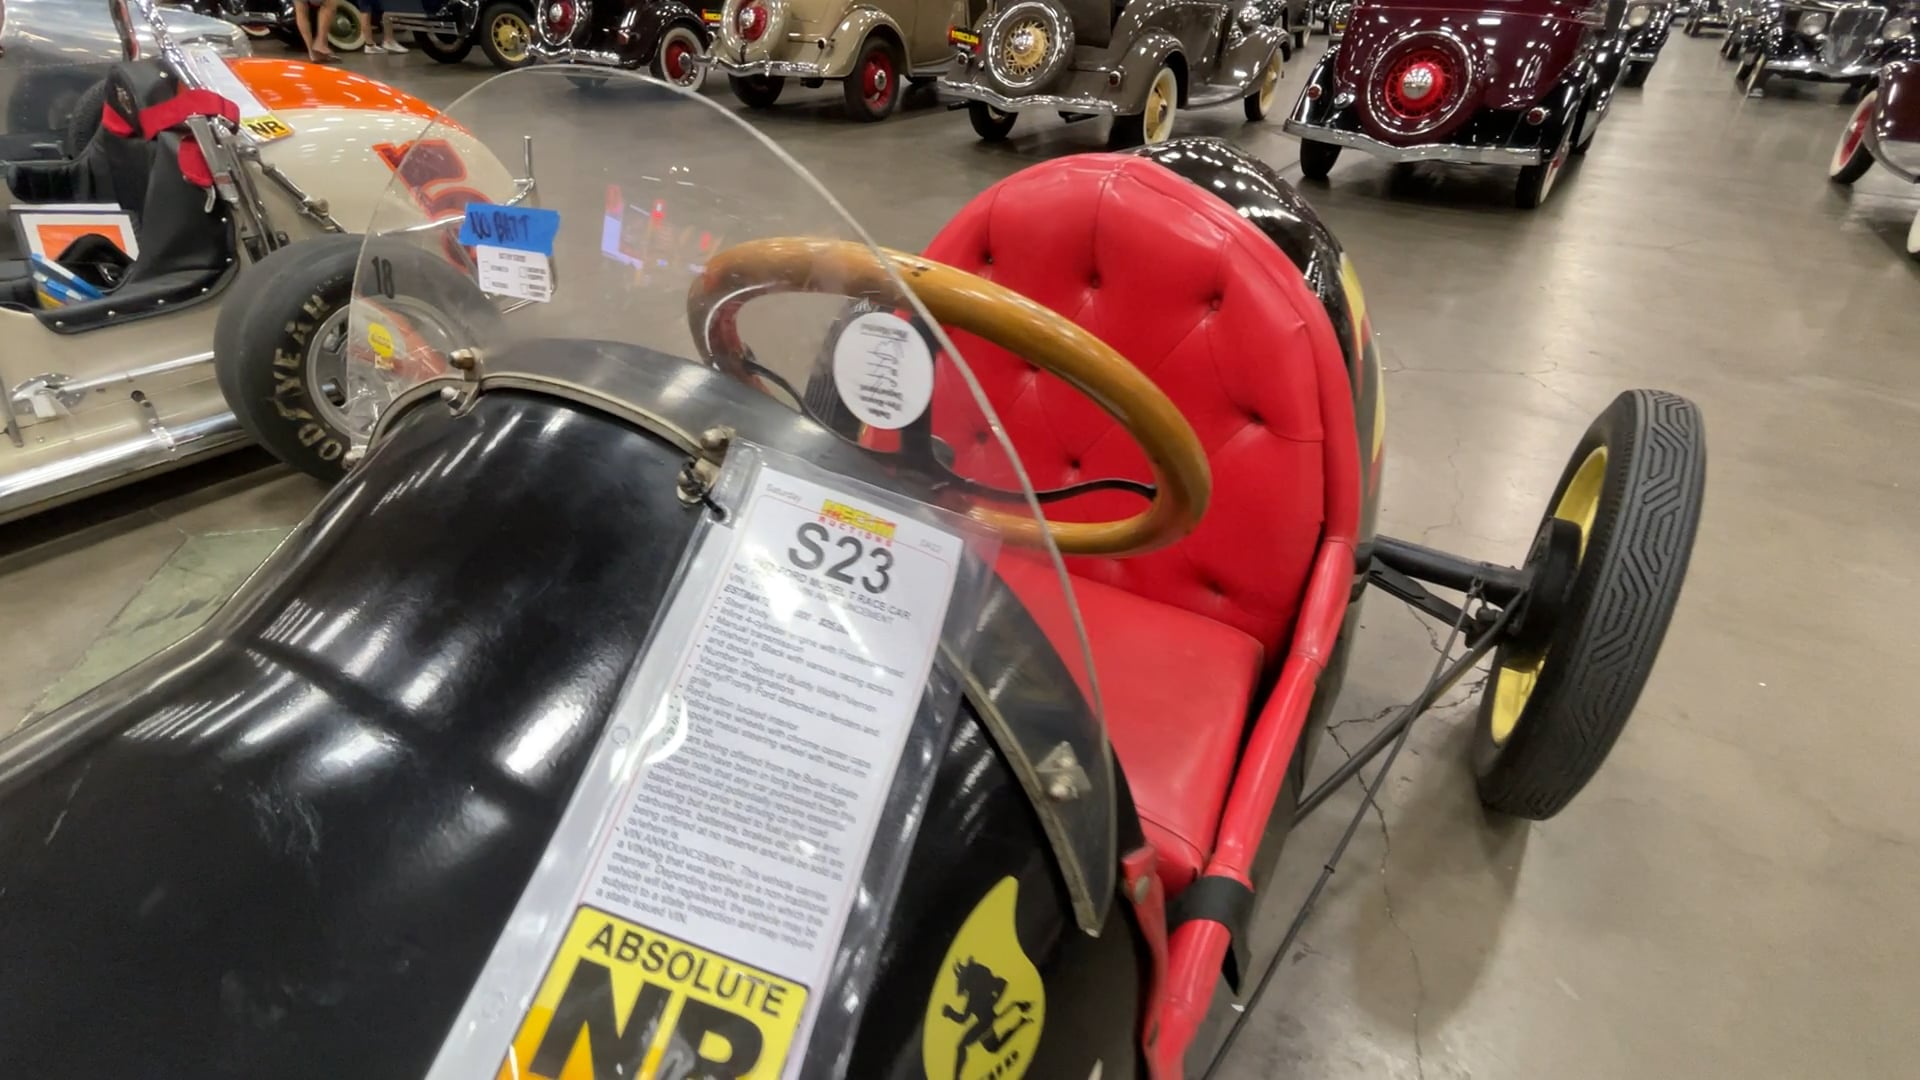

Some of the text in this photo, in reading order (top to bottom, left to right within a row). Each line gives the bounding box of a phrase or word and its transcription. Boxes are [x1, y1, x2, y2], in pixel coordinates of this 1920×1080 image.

[371, 256, 395, 298] 18
[272, 293, 343, 461] ODYEAR
[765, 483, 803, 503] Saturday
[788, 521, 895, 595] S23
[857, 594, 886, 611] RACE
[888, 606, 911, 620] CAR
[585, 922, 789, 1018] ABSOLUTE
[529, 956, 763, 1080] NR
